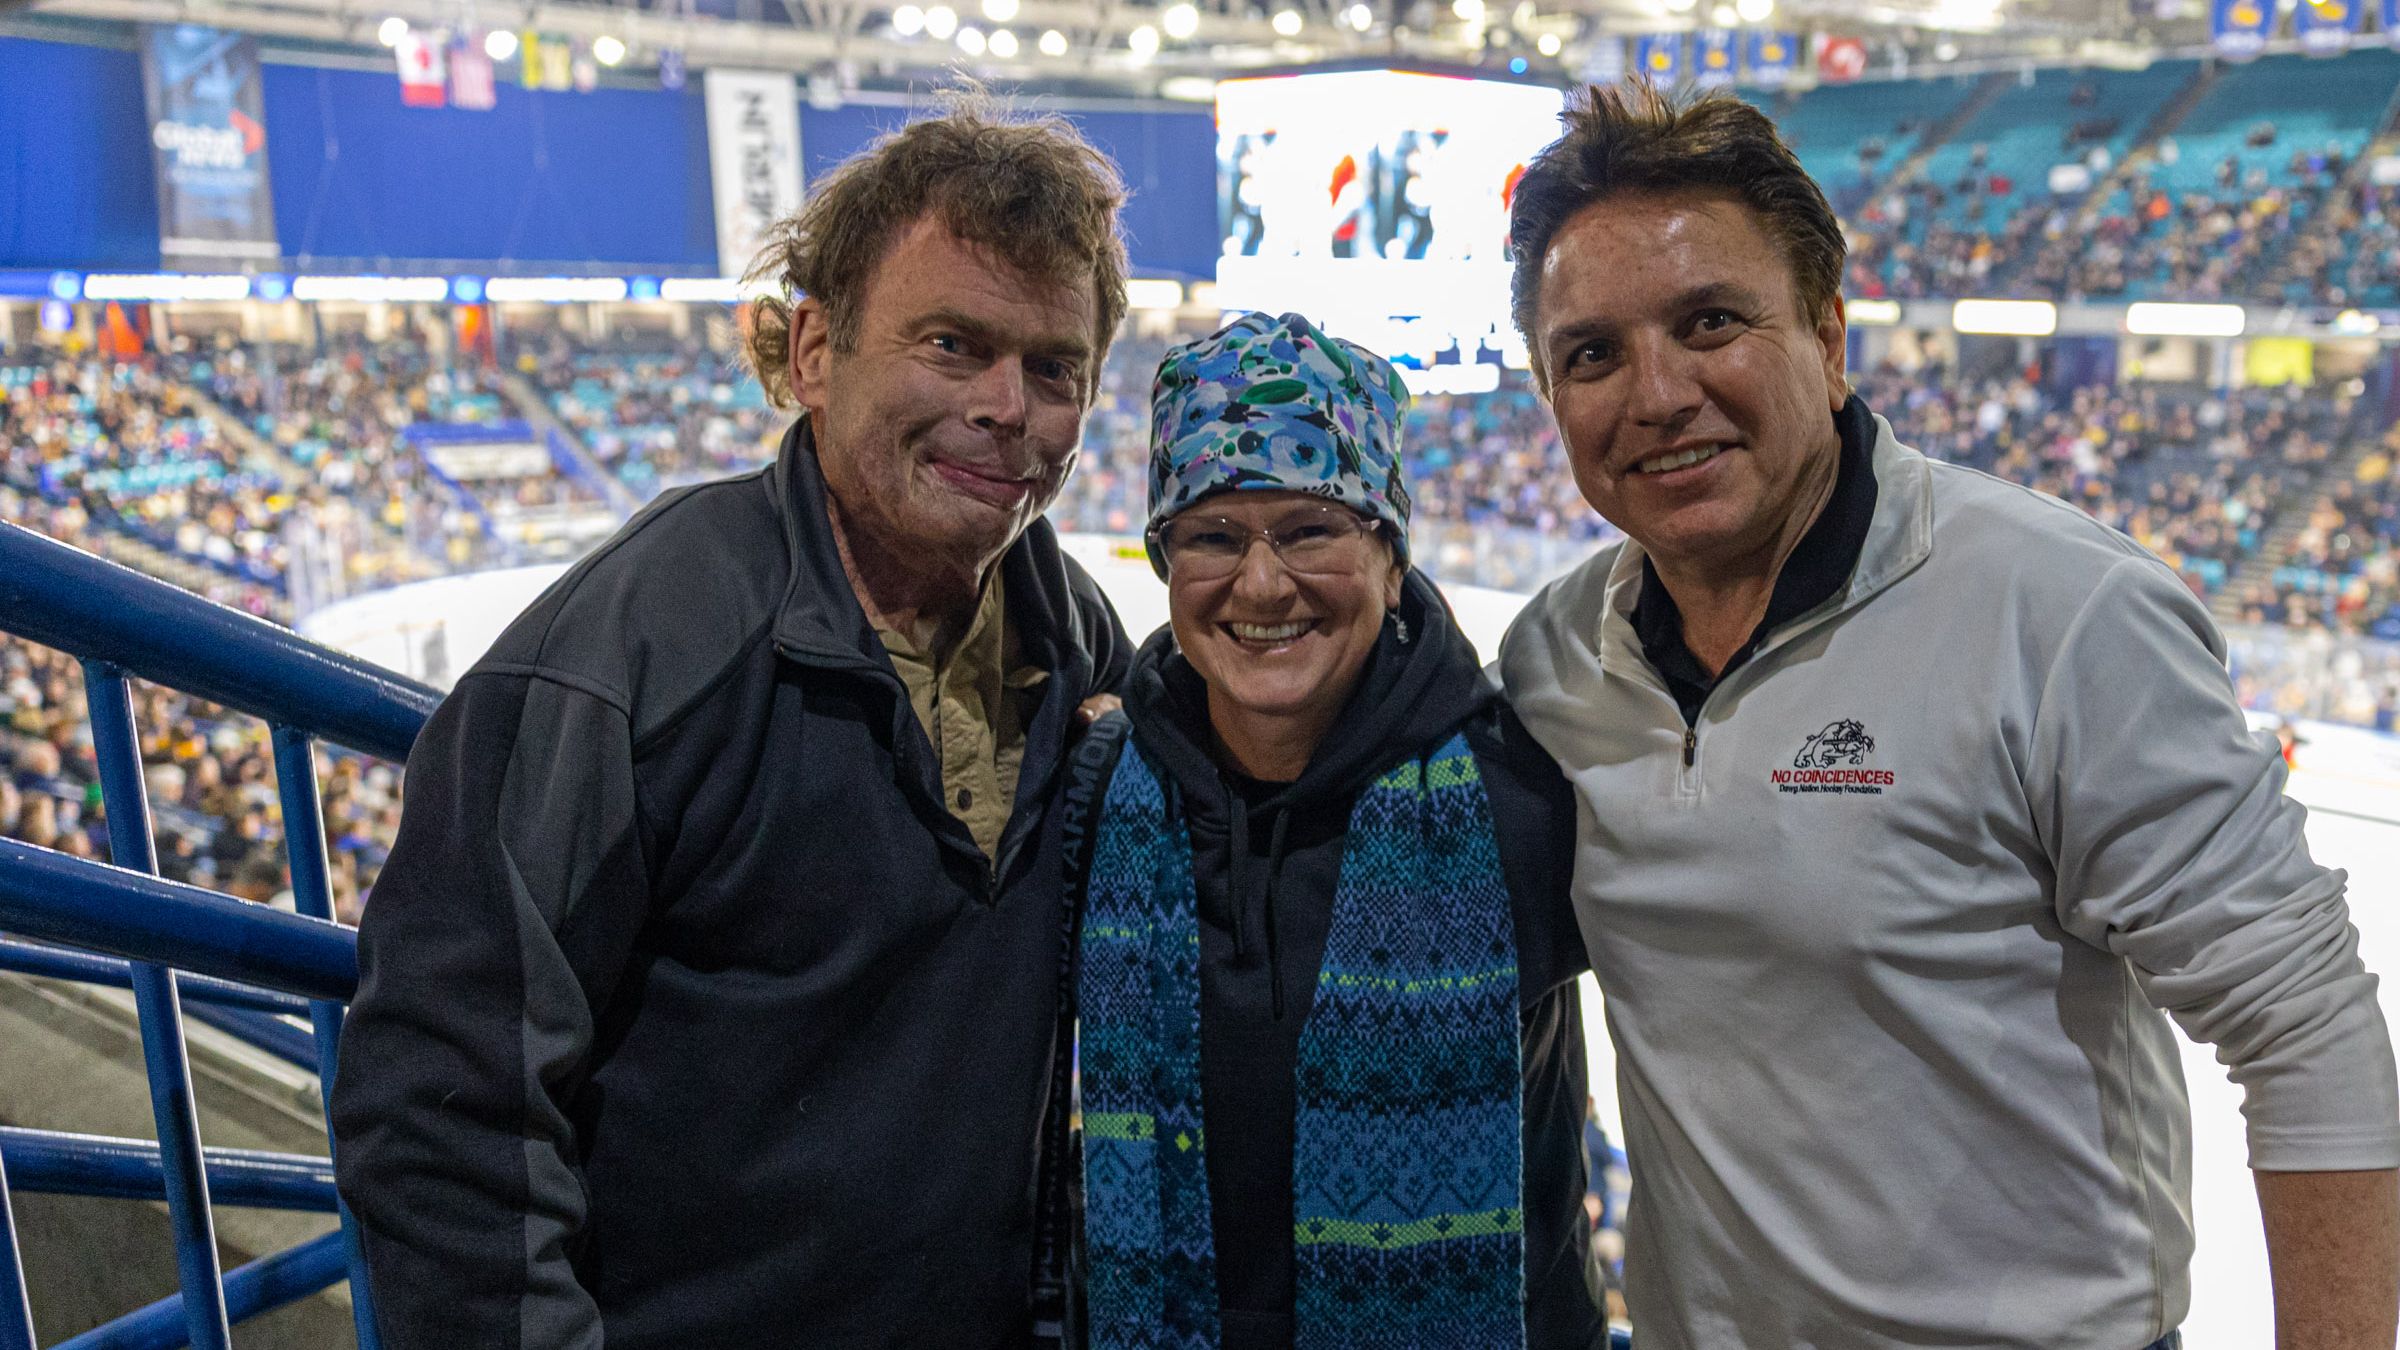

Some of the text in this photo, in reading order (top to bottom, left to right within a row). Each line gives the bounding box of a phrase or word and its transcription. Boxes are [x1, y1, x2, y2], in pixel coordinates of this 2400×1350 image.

[1771, 769, 1895, 786] NO COINCIDENCES
[1062, 717, 1123, 870] ARMOU
[1844, 784, 1882, 795] Foundation
